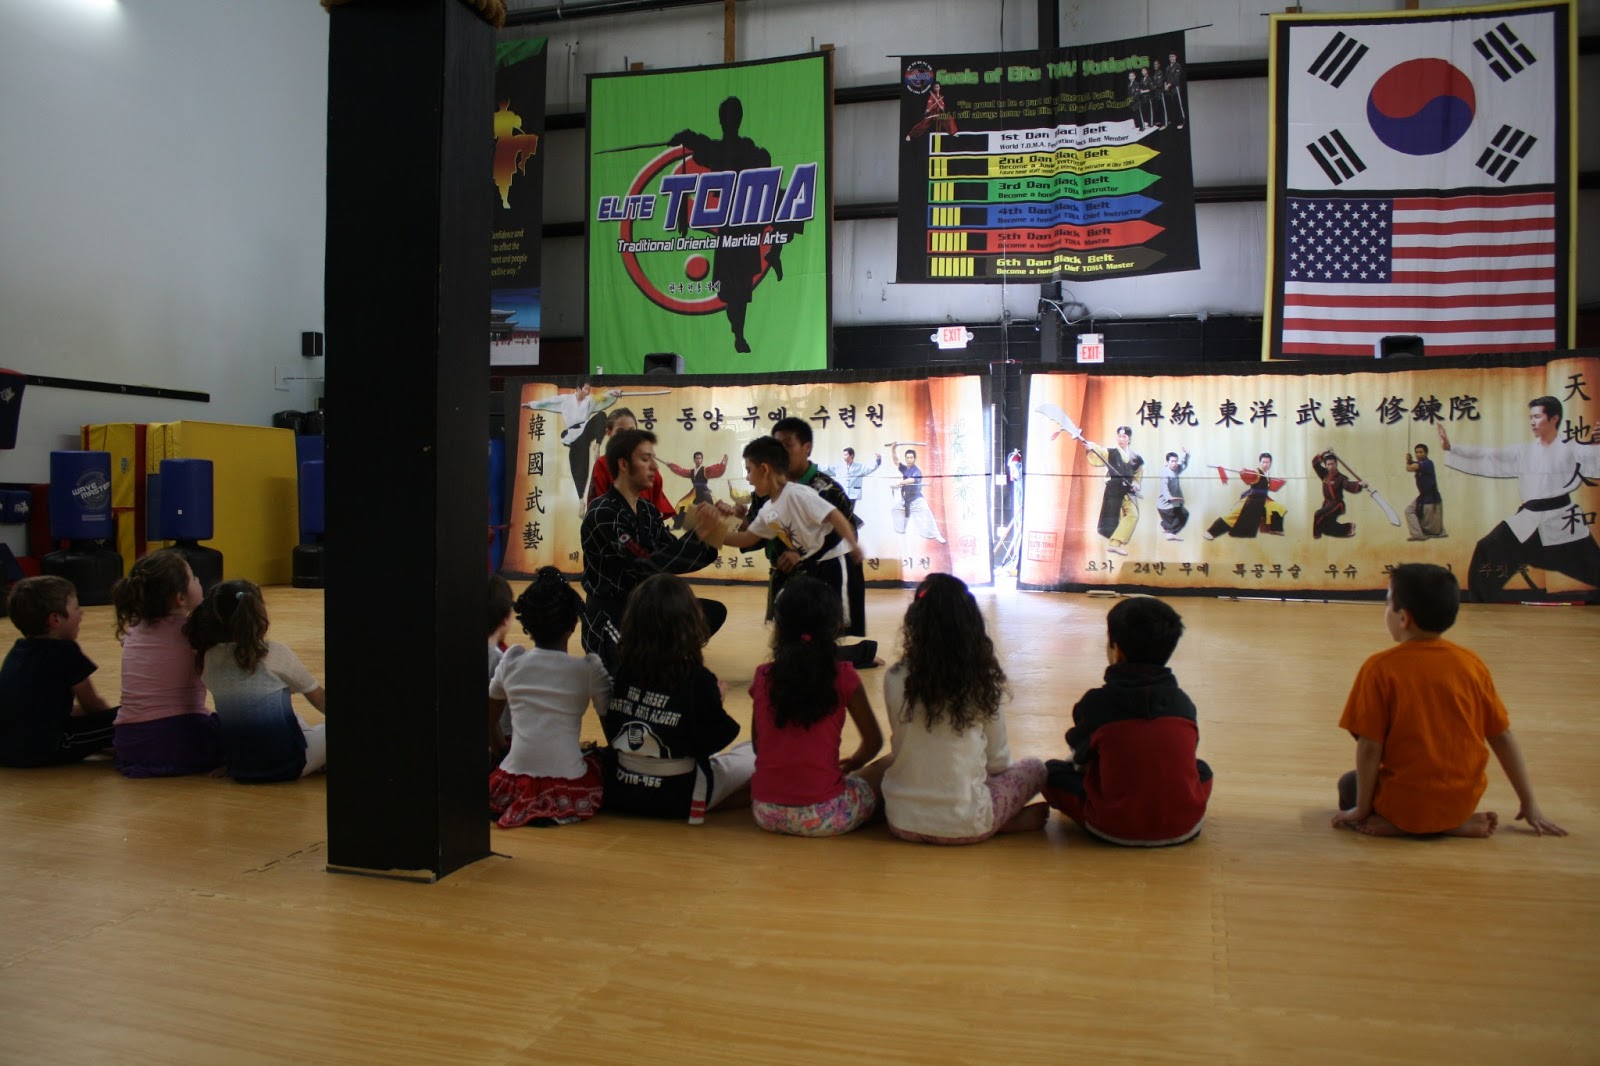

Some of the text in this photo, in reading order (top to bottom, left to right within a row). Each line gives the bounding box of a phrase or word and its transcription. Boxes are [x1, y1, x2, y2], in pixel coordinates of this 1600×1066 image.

[984, 67, 1002, 83] of
[1026, 132, 1050, 140] Dan
[1082, 126, 1108, 136] Belt
[999, 156, 1024, 164] 2nd
[1084, 148, 1110, 158] Belt
[998, 176, 1110, 190] 3rd Dan Black Belt
[660, 162, 818, 230] TOMA
[1083, 186, 1118, 195] Instructor
[597, 194, 656, 220] ELITE
[998, 201, 1111, 215] 4th Dan Black Belt
[1104, 208, 1142, 217] Instructor
[1027, 232, 1051, 240] Dan
[1054, 229, 1080, 238] Black
[1087, 227, 1112, 237] Belt
[618, 230, 788, 252] Traditional Oriental Martial Arts
[511, 254, 528, 264] people
[996, 258, 1020, 266] 6th
[1054, 255, 1082, 264] Black
[1088, 254, 1114, 263] Belt
[1082, 264, 1104, 272] TOMA
[1106, 262, 1134, 270] Master
[943, 328, 962, 342] EXIT
[1082, 346, 1100, 360] EXIT
[638, 403, 884, 431] 통 동양 무예 수련원
[1136, 398, 1199, 428] 傳統
[1215, 398, 1278, 428] 東洋
[1296, 396, 1360, 428] 武藝
[1561, 372, 1599, 535] 天地人和
[72, 482, 97, 496] WAVE
[712, 556, 755, 569] 통검도
[1085, 560, 1115, 574] 요가
[1133, 561, 1166, 576] 24반
[1179, 562, 1210, 576] 무예
[1324, 564, 1358, 580] 우슈
